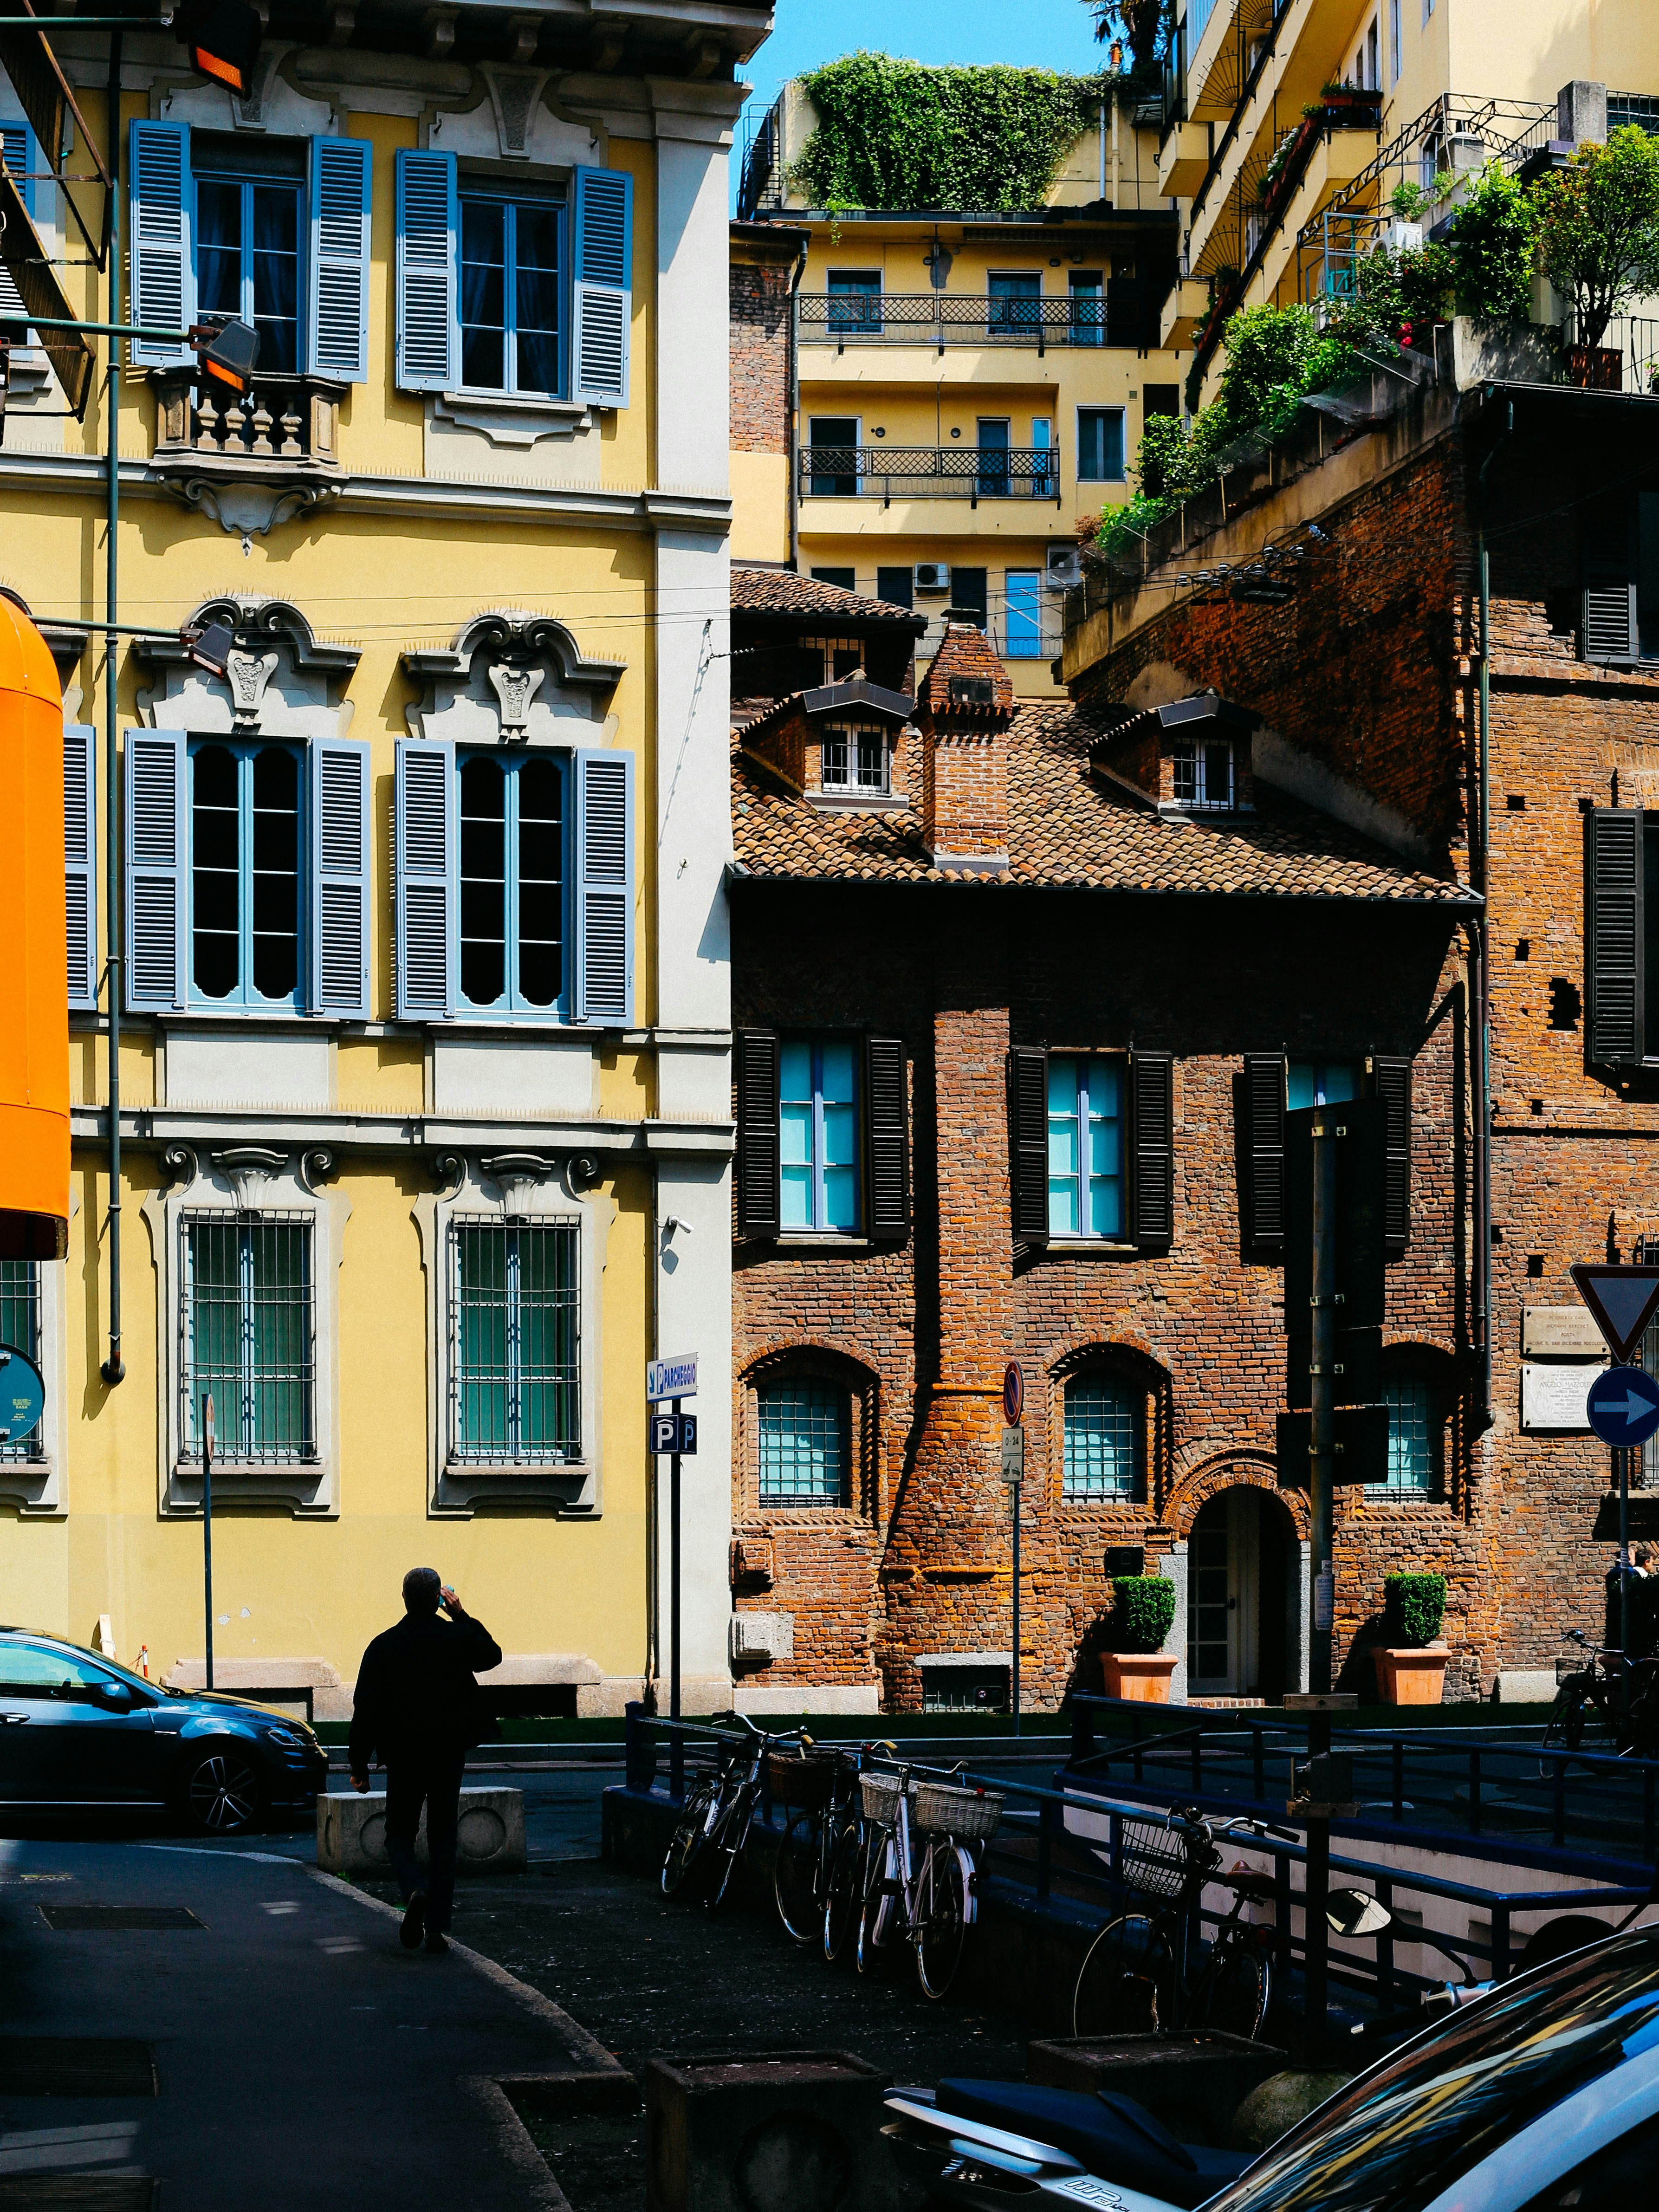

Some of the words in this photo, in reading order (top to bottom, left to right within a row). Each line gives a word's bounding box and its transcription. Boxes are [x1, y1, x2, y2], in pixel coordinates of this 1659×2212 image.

[664, 1362, 695, 1389] PARCHEGGIO
[657, 1423, 674, 1449] P
[685, 1424, 693, 1449] P
